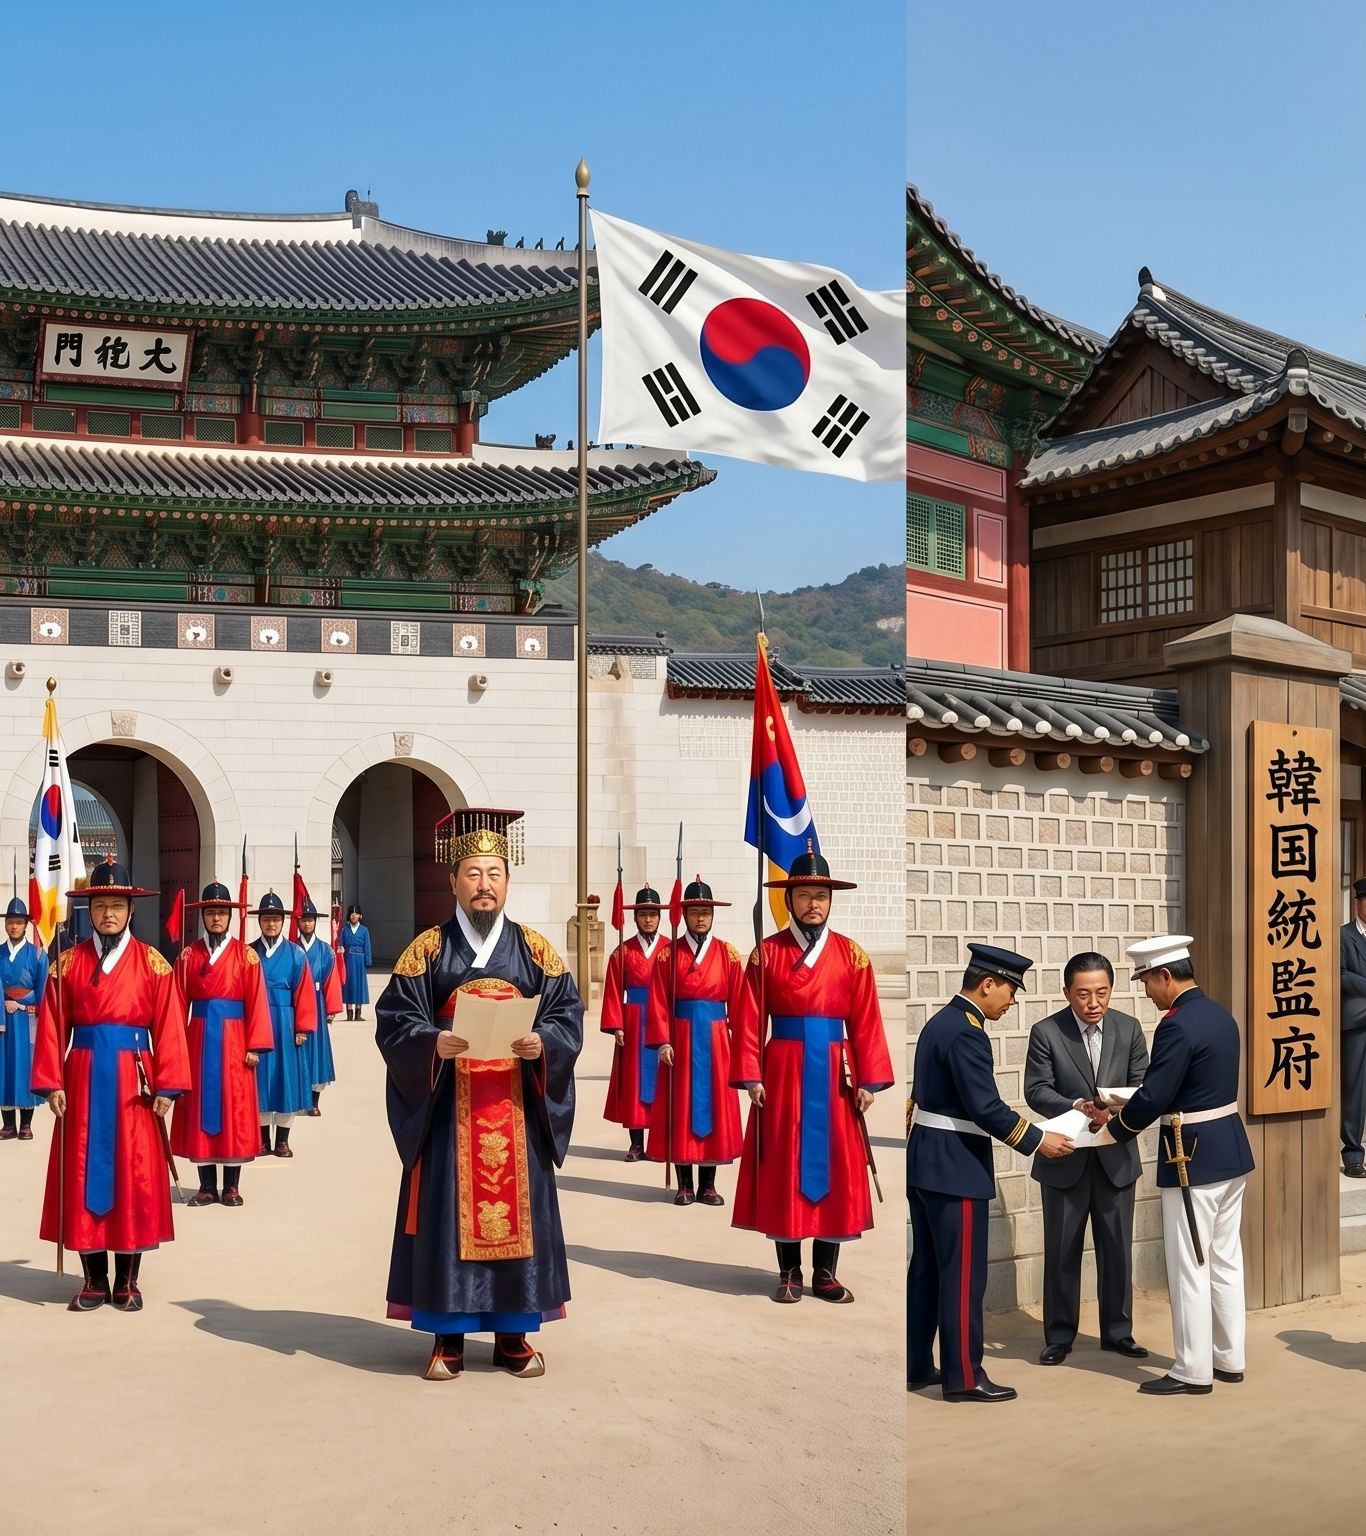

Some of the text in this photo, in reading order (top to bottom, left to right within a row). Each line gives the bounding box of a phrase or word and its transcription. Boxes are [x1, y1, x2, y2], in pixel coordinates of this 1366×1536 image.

[1264, 748, 1322, 1091] 韓国統監府
